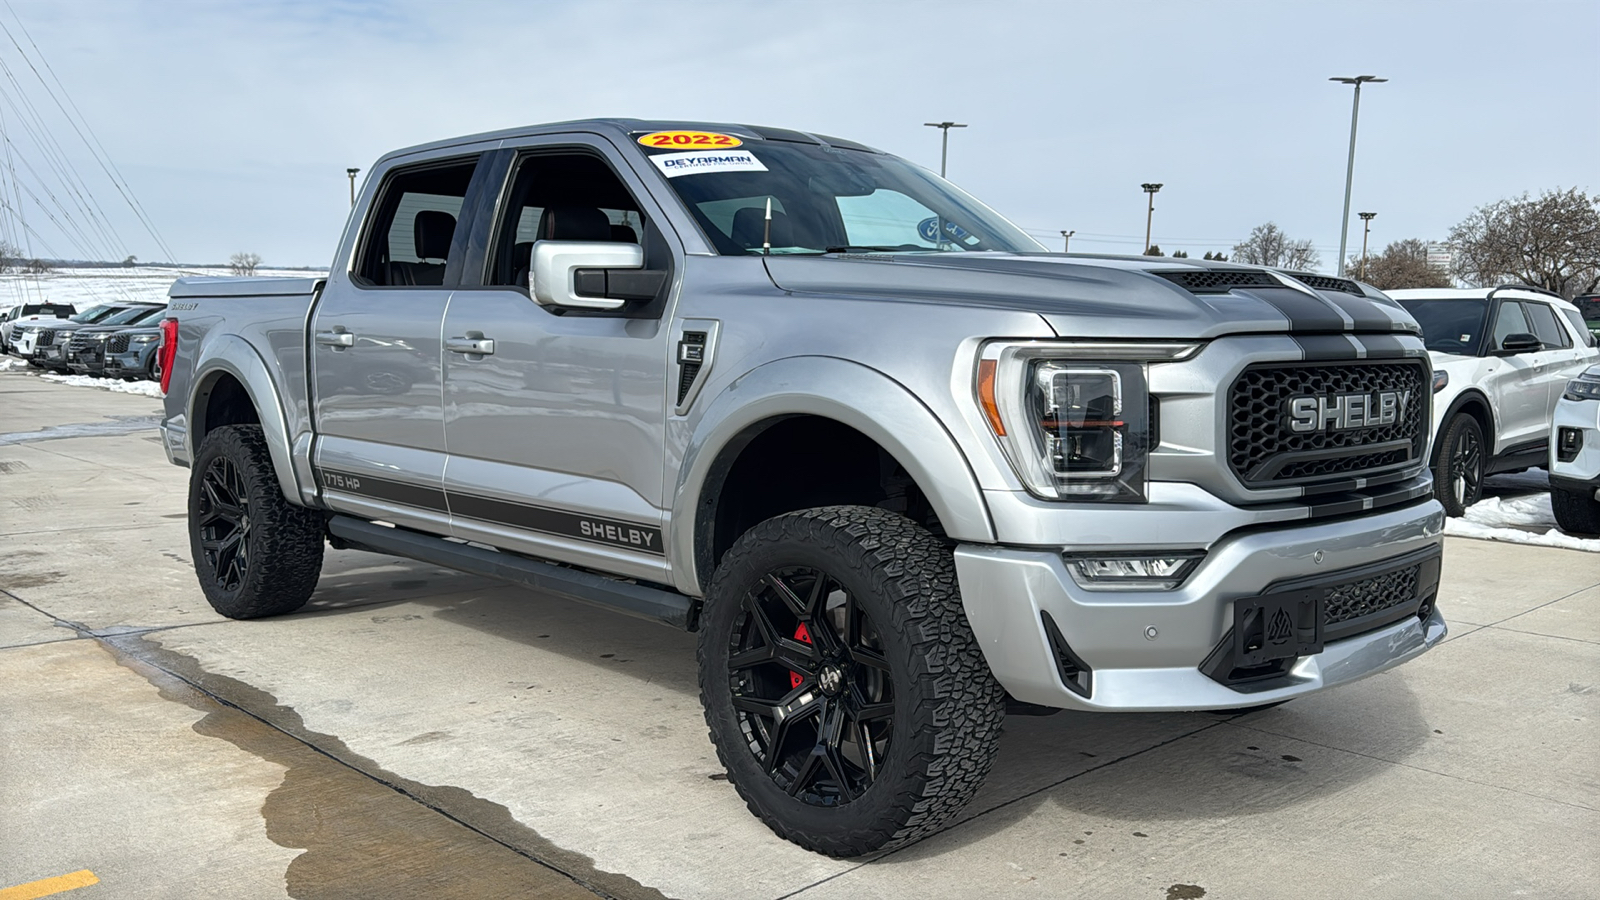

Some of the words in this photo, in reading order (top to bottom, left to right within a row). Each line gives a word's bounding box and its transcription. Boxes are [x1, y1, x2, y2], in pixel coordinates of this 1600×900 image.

[652, 135, 734, 146] 2022
[664, 156, 752, 167] DEYARMAN
[674, 161, 712, 170] CERTIFIED
[171, 303, 199, 311] SHELBY
[1291, 390, 1411, 432] SHELBY
[324, 473, 344, 487] 775
[345, 477, 360, 490] HP
[580, 520, 654, 547] SHELBY
